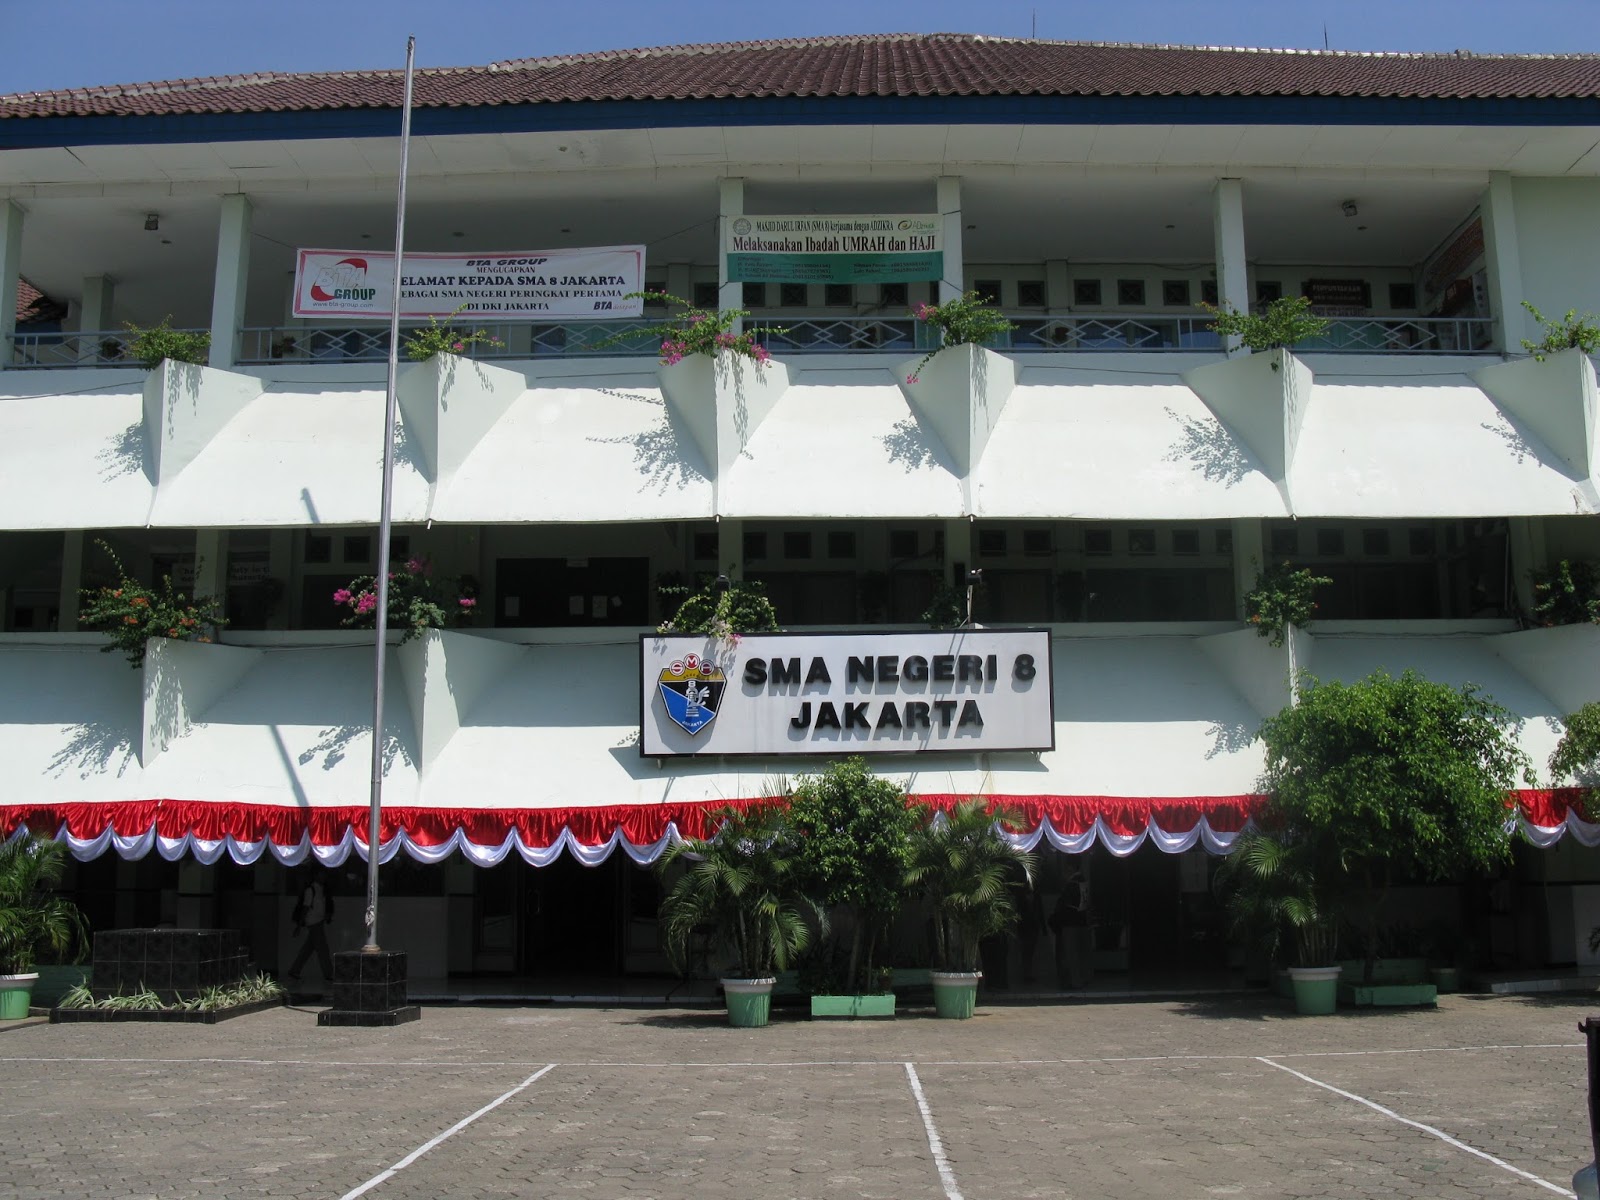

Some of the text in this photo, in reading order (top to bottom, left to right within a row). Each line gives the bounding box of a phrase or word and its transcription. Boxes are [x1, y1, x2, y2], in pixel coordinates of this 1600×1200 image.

[756, 220, 776, 232] MASJID
[776, 220, 794, 232] DARUL
[795, 220, 810, 232] IRFAN
[830, 220, 853, 233] kerjasama
[854, 220, 869, 234] dengan
[870, 220, 894, 231] ADZIKRA
[733, 235, 935, 252] Melaksanakan Ibadah UMRAH dan HAJI
[466, 258, 548, 267] BTA GROUP
[476, 266, 536, 274] MENGUCAPKAN
[315, 267, 366, 288] BTA
[393, 276, 625, 286] ELAMAT KEPADA SMA 8 JAKARTA
[334, 288, 376, 301] GROUP
[402, 290, 622, 298] EBAGAI SMA NEGERI PERINGKAT PERTAMA
[504, 302, 549, 310] JAKARTA
[593, 301, 612, 310] BTA
[745, 653, 1036, 685] SMA NEGERI 8
[791, 700, 984, 729] JAKARTA
